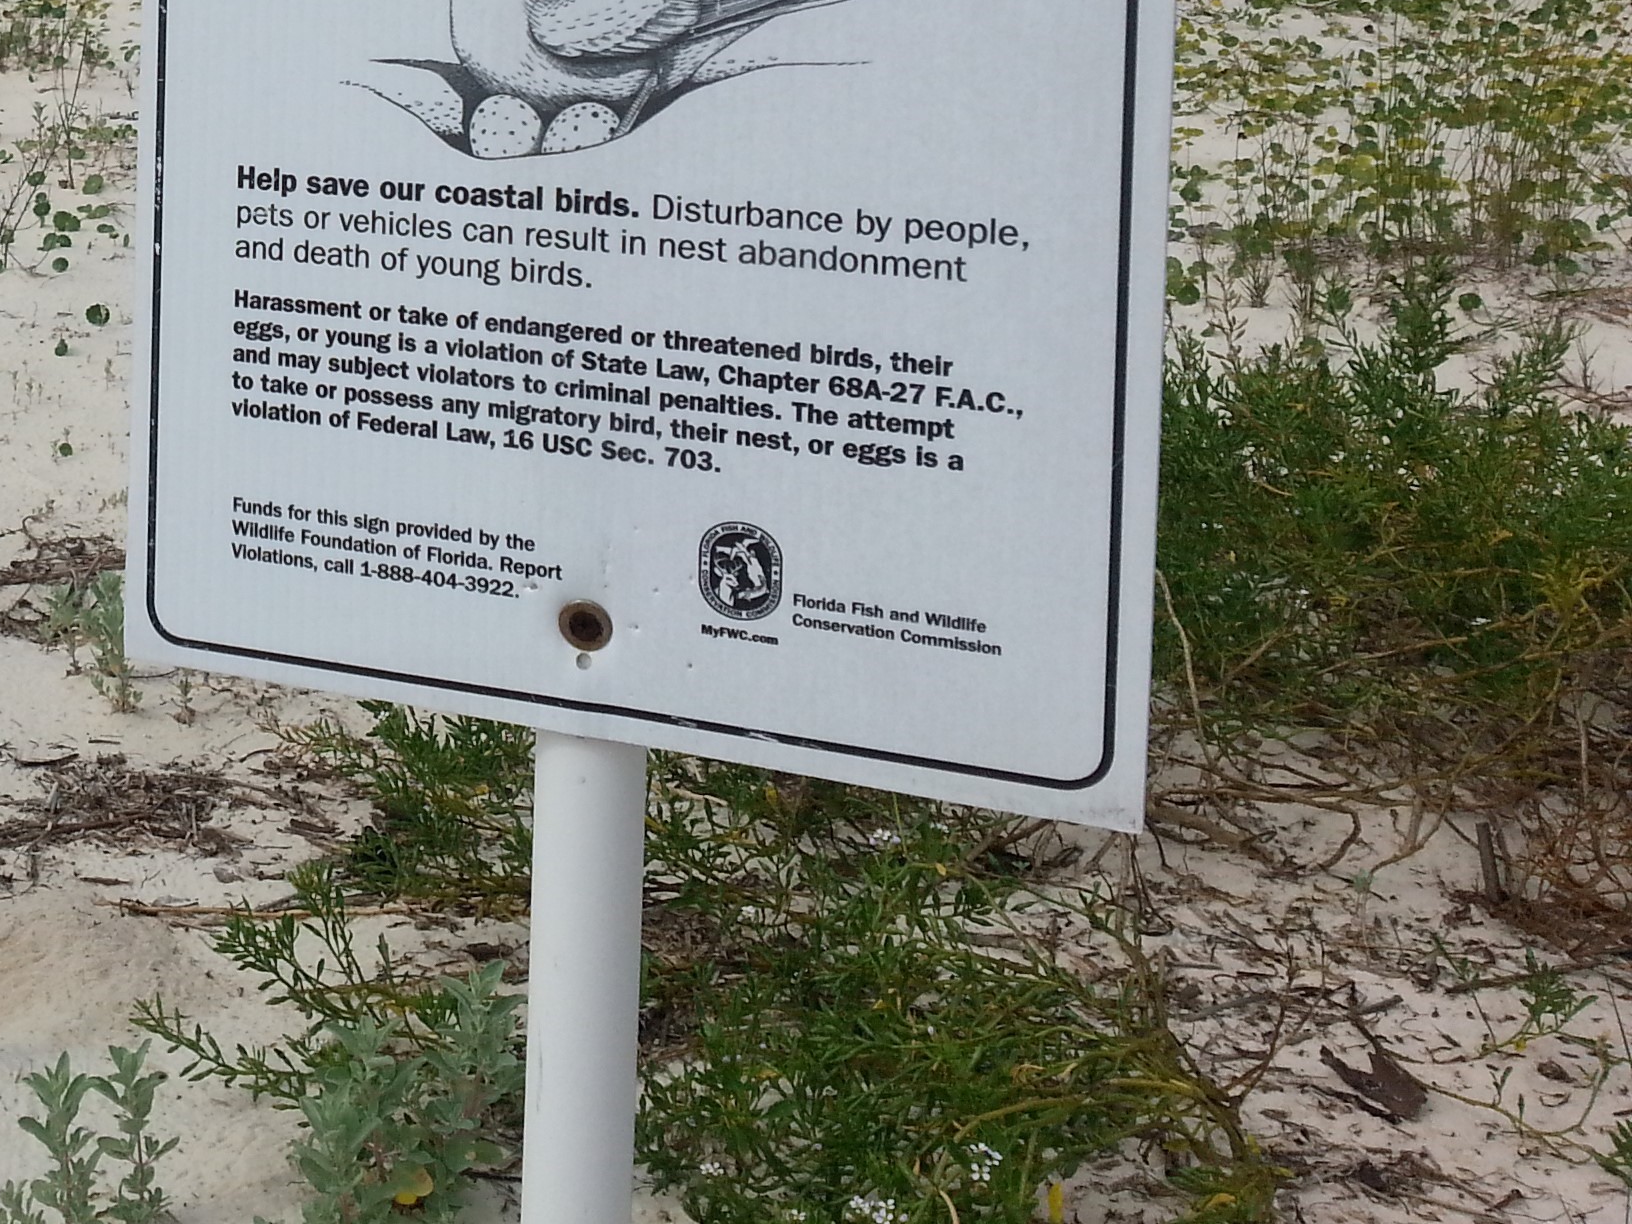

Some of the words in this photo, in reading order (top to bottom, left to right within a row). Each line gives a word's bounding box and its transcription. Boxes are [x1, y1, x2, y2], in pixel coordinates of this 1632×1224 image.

[237, 165, 297, 197] Help
[306, 176, 369, 198] save
[380, 181, 426, 202] our
[435, 184, 543, 211] coastal
[555, 187, 639, 218] birds.
[653, 194, 843, 233] Disturbance
[856, 208, 893, 243] by
[905, 218, 1029, 252] people,
[237, 203, 293, 229] pets
[304, 210, 331, 230] or
[339, 209, 452, 240] vehicles
[463, 223, 513, 245] can
[526, 226, 610, 253] result
[621, 229, 646, 256] in
[659, 238, 728, 263] nest
[738, 239, 968, 282] abandonment
[235, 237, 283, 261] and
[294, 239, 369, 269] death
[381, 247, 410, 272] of
[416, 254, 501, 286] young
[511, 256, 592, 288] birds.
[234, 289, 362, 319] Harassment
[369, 306, 392, 322] or
[397, 305, 448, 327] take
[456, 311, 479, 330] of
[485, 315, 622, 345] endangered
[631, 331, 656, 348] or
[662, 330, 801, 362] threatened
[810, 343, 882, 375] birds,
[889, 352, 954, 377] their
[233, 321, 290, 344] eggs,
[297, 327, 319, 343] or
[325, 328, 392, 354] young
[398, 331, 417, 352] is
[424, 339, 438, 355] a
[445, 338, 543, 366] violation
[551, 349, 575, 369] of
[580, 351, 647, 376] State
[656, 358, 710, 387] Law,
[718, 364, 821, 394] Chapter
[828, 375, 926, 405] 68A-27
[935, 386, 1023, 420] F.A.C.,
[233, 346, 270, 365] and
[278, 352, 322, 374] may
[328, 355, 410, 380] subject
[416, 363, 515, 391] violators
[522, 374, 547, 395] to
[554, 378, 650, 406] criminal
[659, 392, 782, 420] penalties.
[791, 401, 839, 426] The
[847, 410, 955, 442] attempt
[231, 371, 254, 390] to
[260, 373, 308, 396] take
[315, 384, 337, 400] or
[344, 387, 434, 410] possess
[441, 398, 480, 420] any
[488, 400, 602, 434] migratory
[609, 411, 662, 441] bird,
[669, 419, 729, 444] their
[736, 430, 800, 457] nest,
[808, 438, 835, 456] or
[842, 442, 907, 467] eggs
[916, 445, 938, 468] is
[947, 454, 964, 471] a
[231, 398, 321, 426] violation
[329, 409, 351, 429] of
[357, 411, 438, 439] Federal
[446, 421, 496, 450] Law,
[503, 429, 534, 451] 16
[543, 432, 593, 457] USC
[600, 440, 654, 465] Sec.
[664, 446, 721, 473] 703.
[232, 519, 295, 543] Wildlife
[301, 528, 397, 557] Foundation
[403, 544, 421, 561] of
[427, 546, 493, 571] Florida.
[500, 556, 563, 580] Report
[233, 496, 282, 518] Funds
[287, 504, 312, 522] for
[317, 508, 348, 527] this
[353, 513, 389, 535] sign
[396, 522, 472, 544] provided
[479, 529, 500, 551] by
[505, 533, 535, 552] the
[231, 542, 318, 573] Violations,
[324, 558, 354, 575] call
[360, 560, 521, 598] 1-888-404-3922.
[701, 624, 779, 645] MyFWC.com
[792, 613, 895, 640] Conservation
[900, 629, 1002, 656] Commission
[793, 593, 846, 614] Florida
[851, 602, 884, 619] Fish
[889, 610, 920, 624] and
[924, 611, 987, 633] Wildlife
